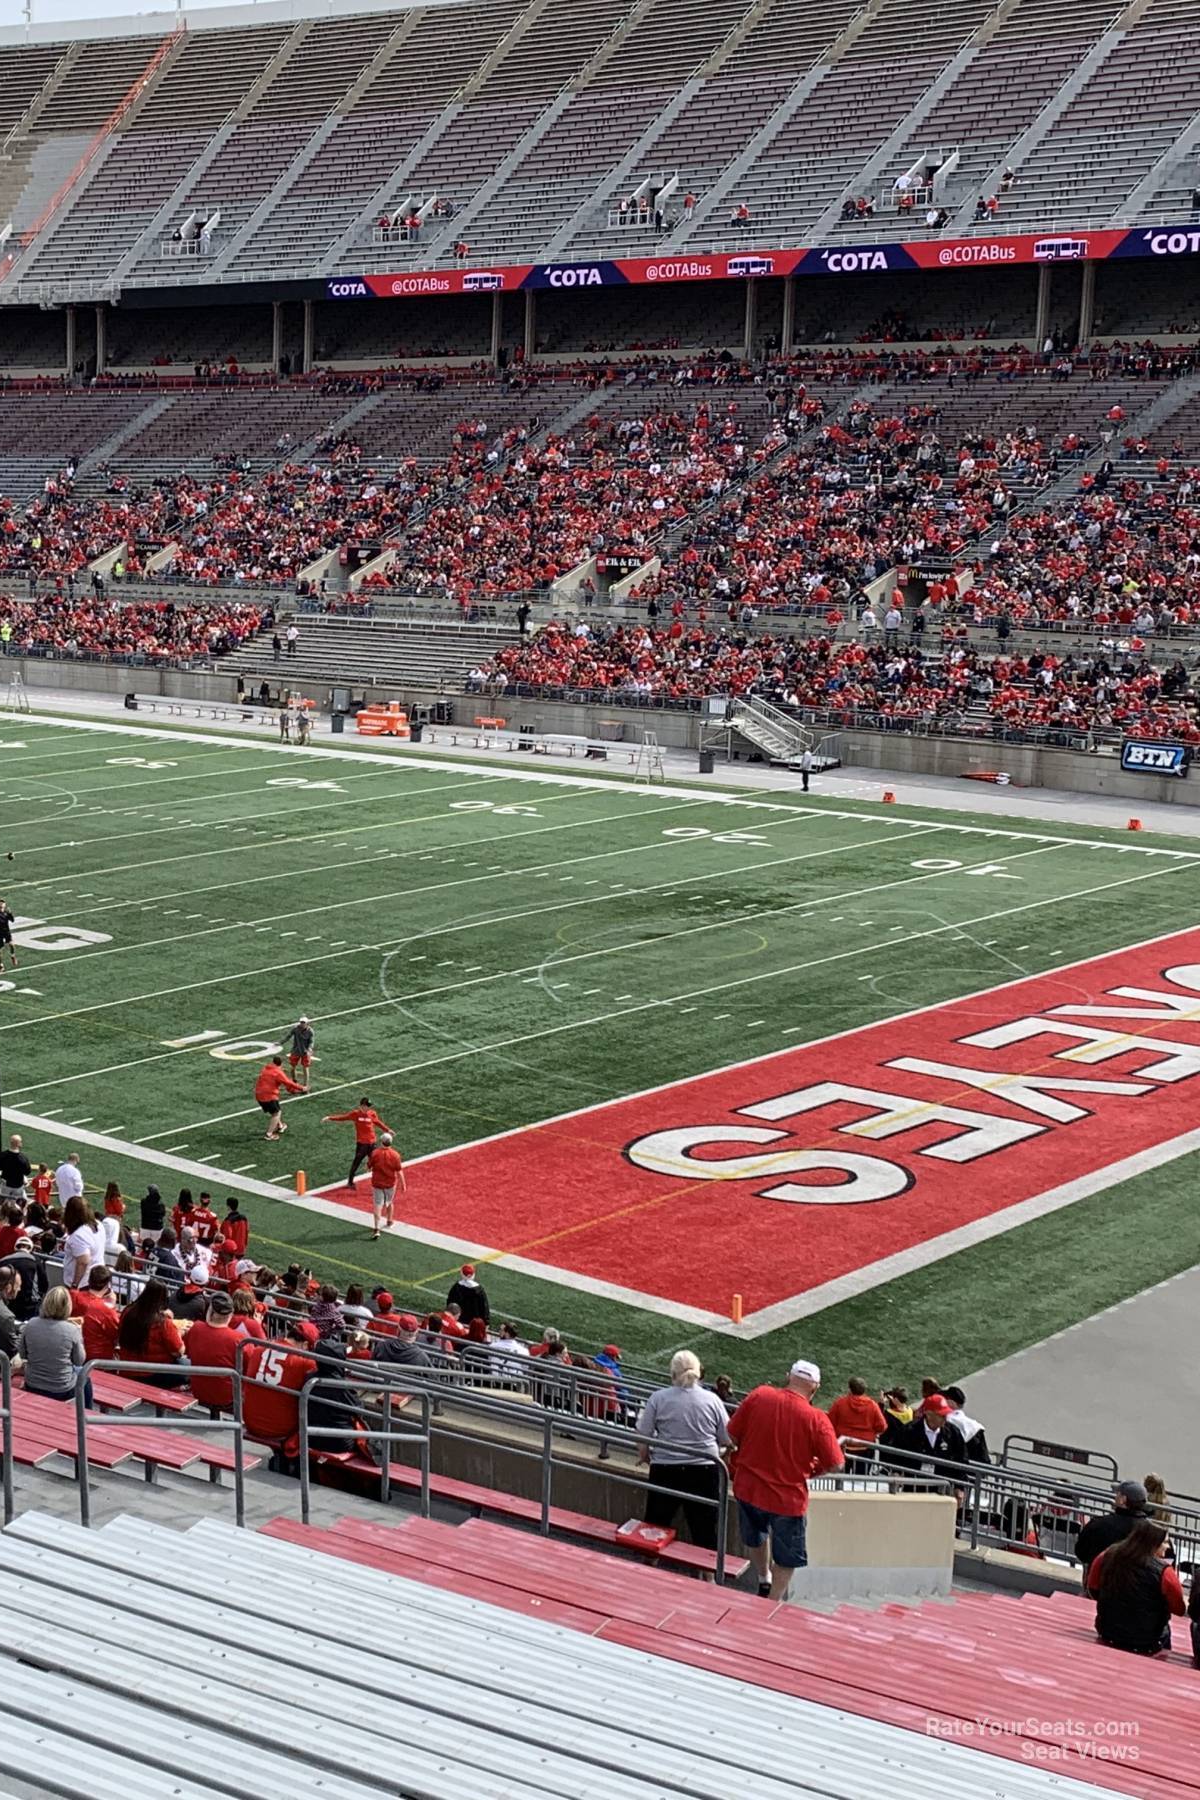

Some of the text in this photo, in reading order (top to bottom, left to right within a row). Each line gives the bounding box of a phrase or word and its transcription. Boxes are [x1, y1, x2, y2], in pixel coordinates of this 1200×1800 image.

[827, 252, 888, 272] COTA
[939, 245, 1016, 266] @COTABus
[549, 268, 602, 287] COTA
[646, 262, 712, 281] @COTABus
[332, 283, 367, 296] COTA
[391, 278, 450, 295] @COTABus
[1127, 746, 1176, 767] BTN
[159, 1030, 283, 1060] 10
[256, 1348, 288, 1386] 15
